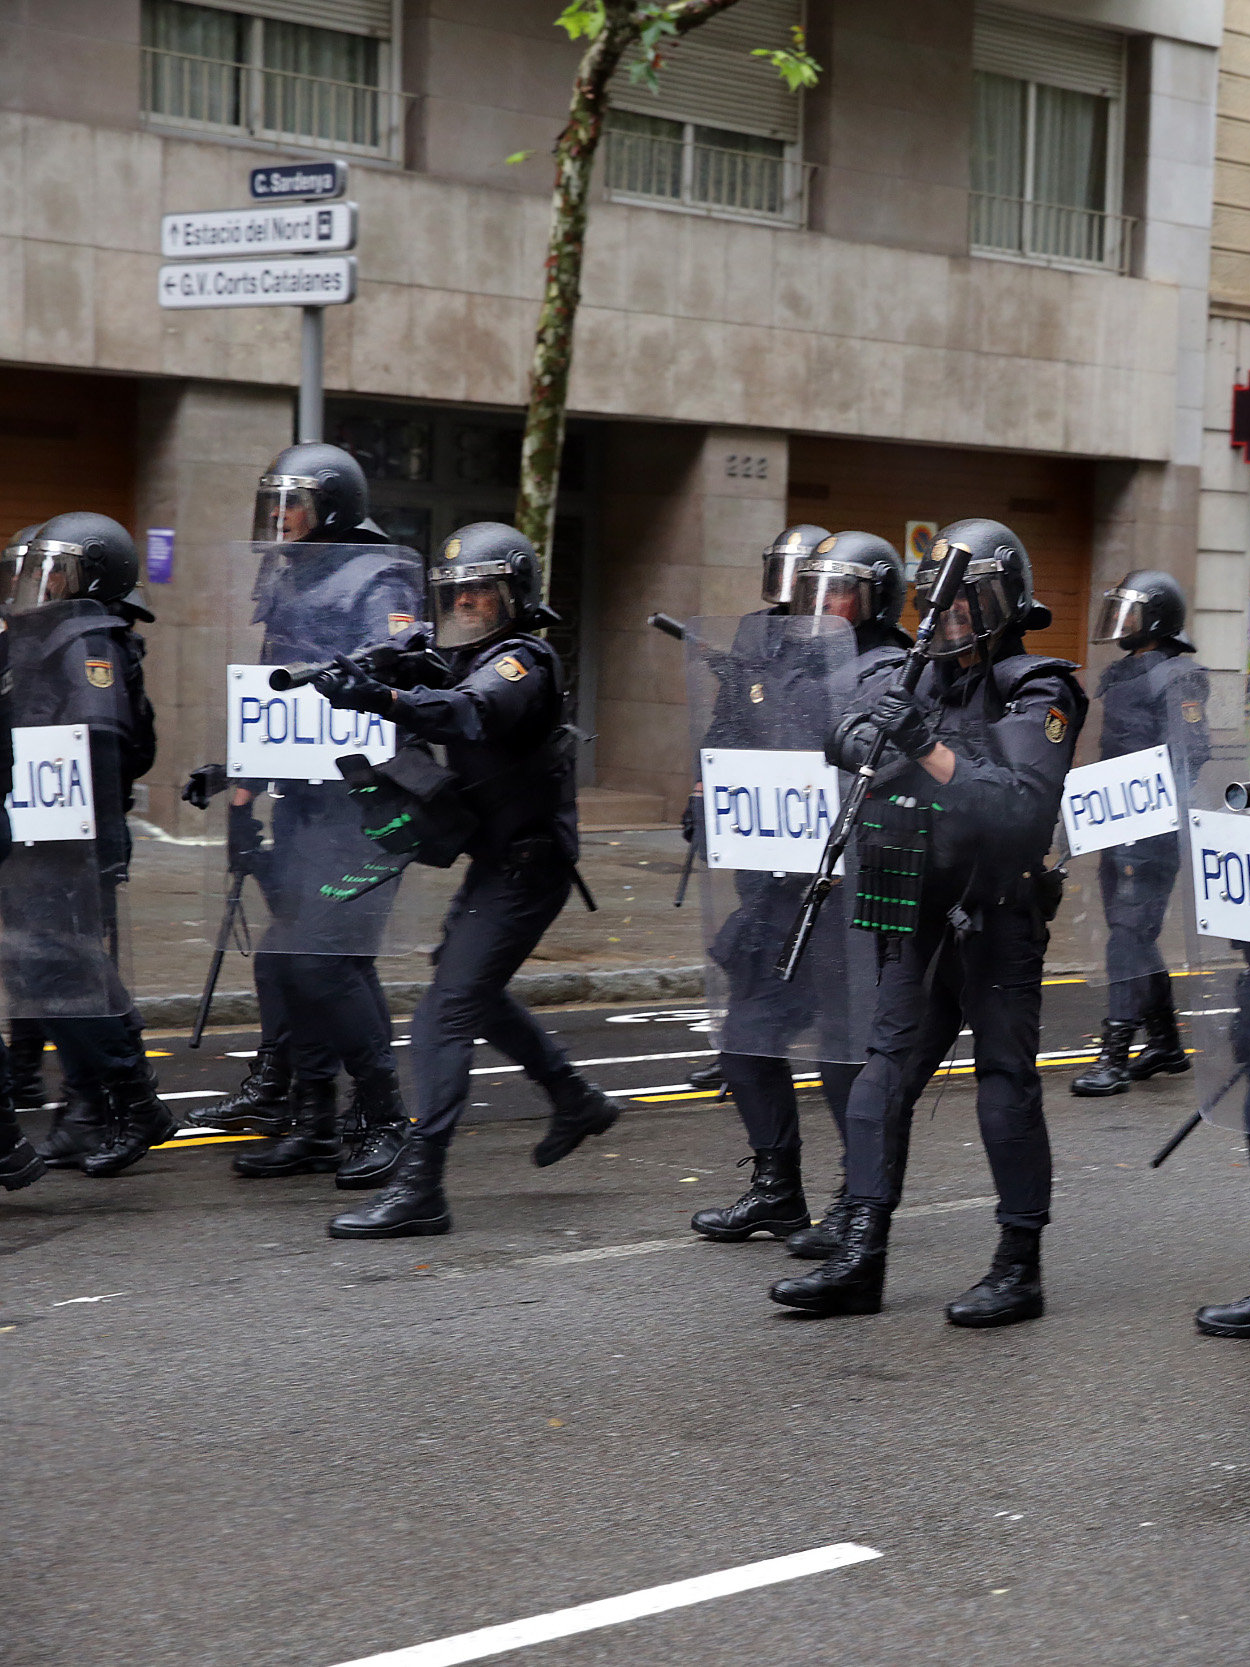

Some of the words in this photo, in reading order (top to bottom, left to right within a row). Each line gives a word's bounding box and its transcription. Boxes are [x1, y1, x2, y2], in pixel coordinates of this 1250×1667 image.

[270, 171, 334, 194] Sardenya
[182, 220, 242, 247] Estació
[247, 217, 269, 242] del
[272, 214, 312, 240] Nord
[213, 271, 257, 295] Corts
[260, 268, 342, 294] Catalanes
[239, 696, 386, 747] POLICIA
[713, 784, 832, 840] POLICIA
[1069, 772, 1173, 831] POLICIA
